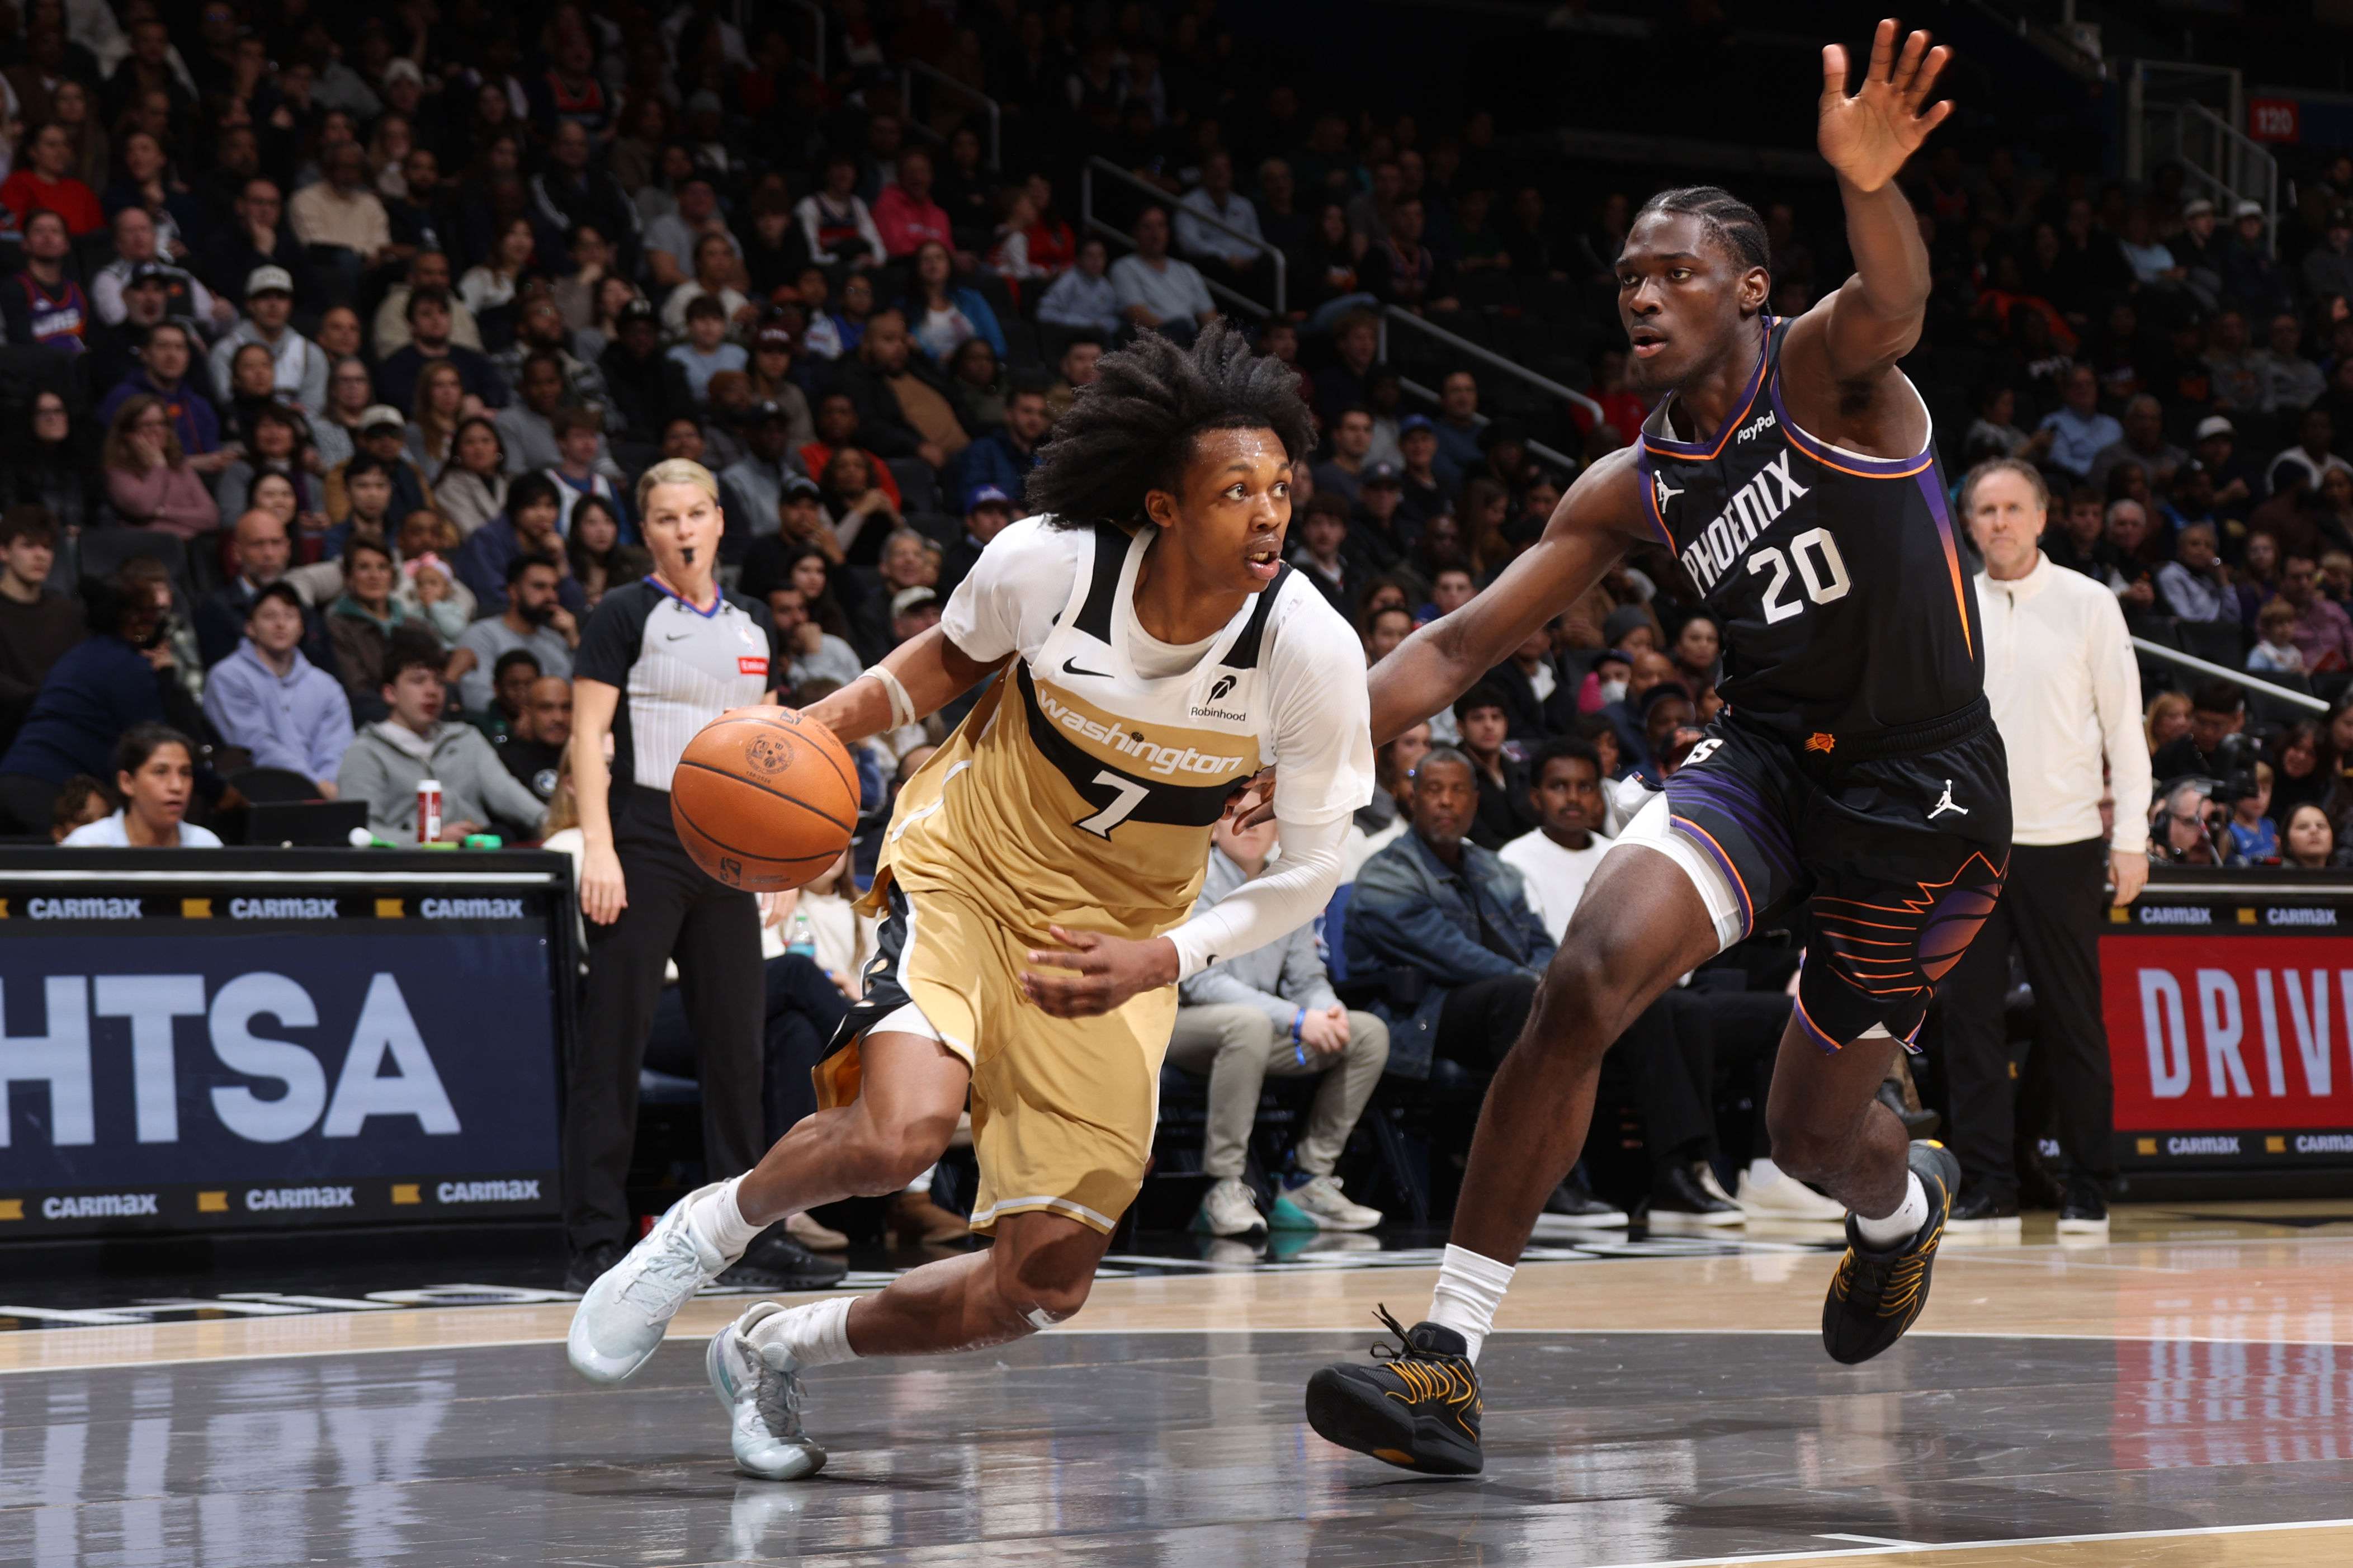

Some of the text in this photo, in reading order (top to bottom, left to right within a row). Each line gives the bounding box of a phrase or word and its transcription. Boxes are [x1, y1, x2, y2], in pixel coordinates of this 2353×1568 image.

[2256, 106, 2294, 136] 120
[1737, 409, 1776, 445] PayPal
[1681, 447, 1812, 600] PHOENIX
[1746, 527, 1854, 625] 20
[1040, 688, 1244, 776] washington
[1190, 707, 1246, 722] Robinhood
[1076, 769, 1151, 840] 7
[0, 971, 462, 1148] HTSA
